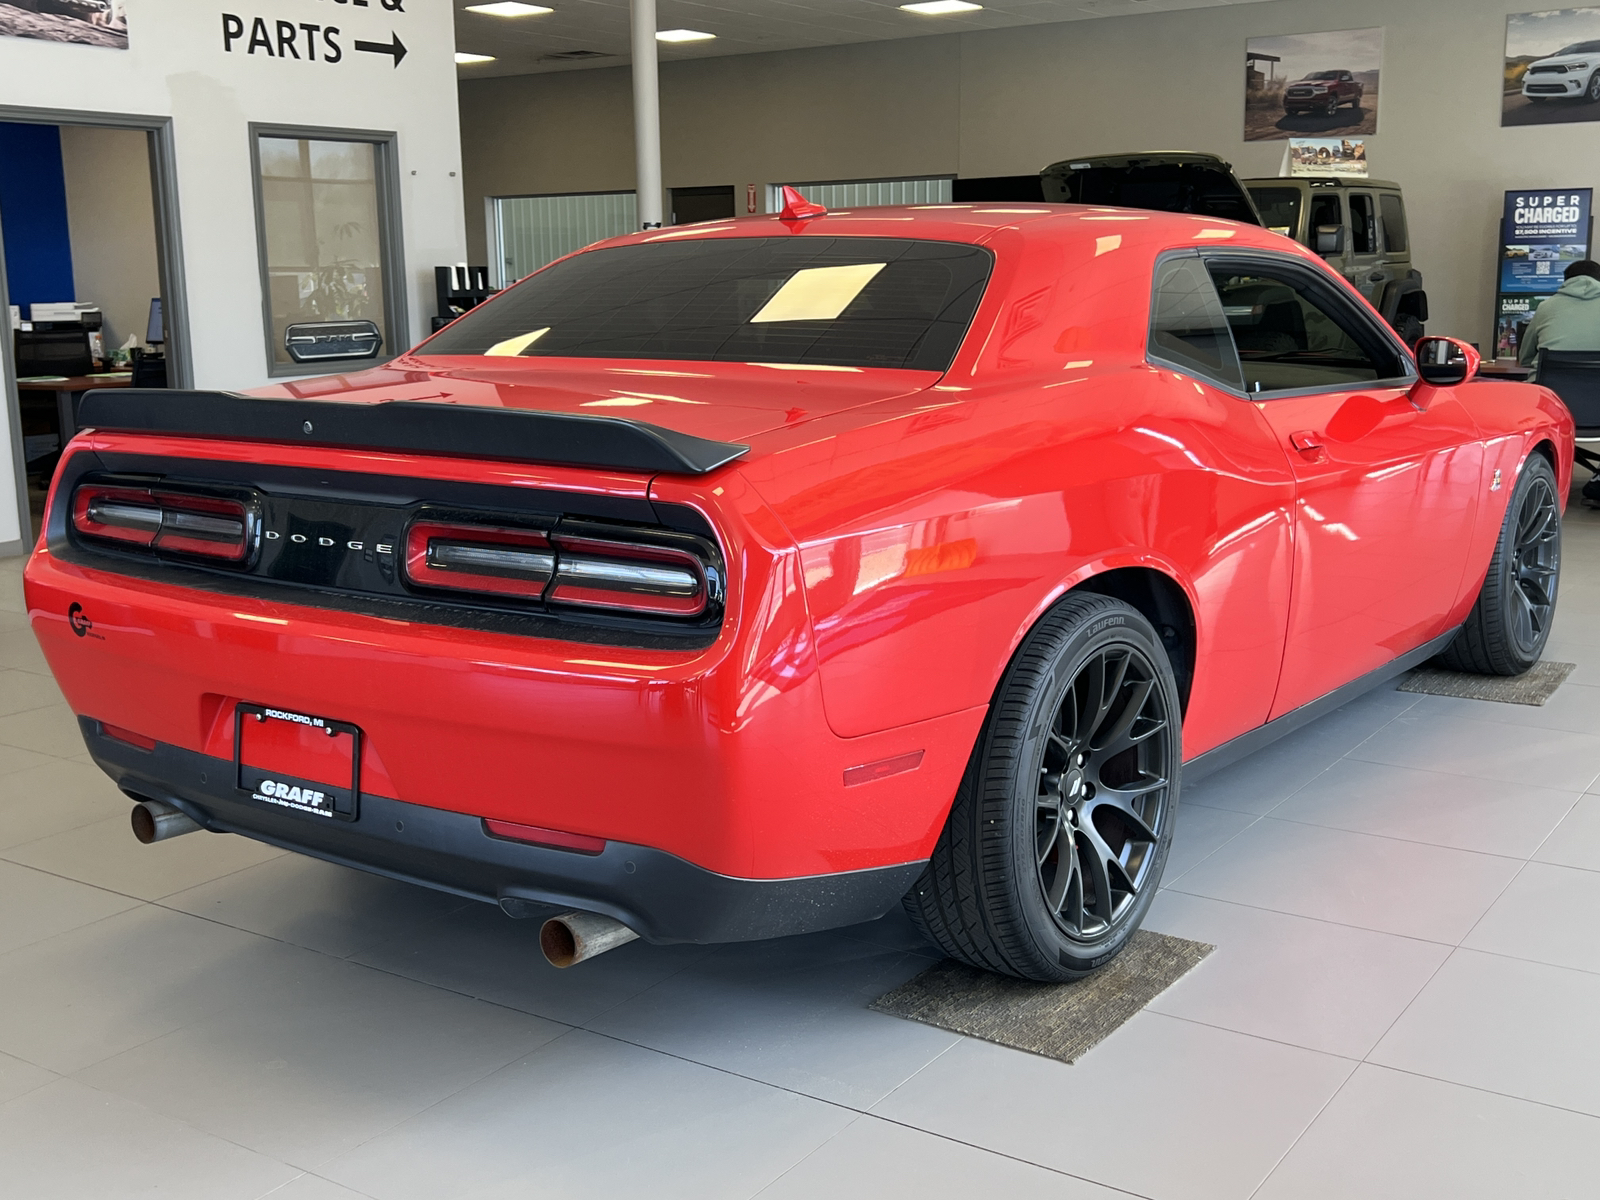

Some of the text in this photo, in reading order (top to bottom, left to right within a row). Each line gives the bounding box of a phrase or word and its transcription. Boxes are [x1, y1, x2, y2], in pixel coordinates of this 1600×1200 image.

[221, 12, 342, 64] PARTS
[1516, 195, 1580, 207] SUPER
[1514, 206, 1580, 224] CHARGED
[265, 530, 392, 554] DODGE
[265, 708, 324, 727] ROCKFORD, MI
[260, 780, 324, 806] GRAFF
